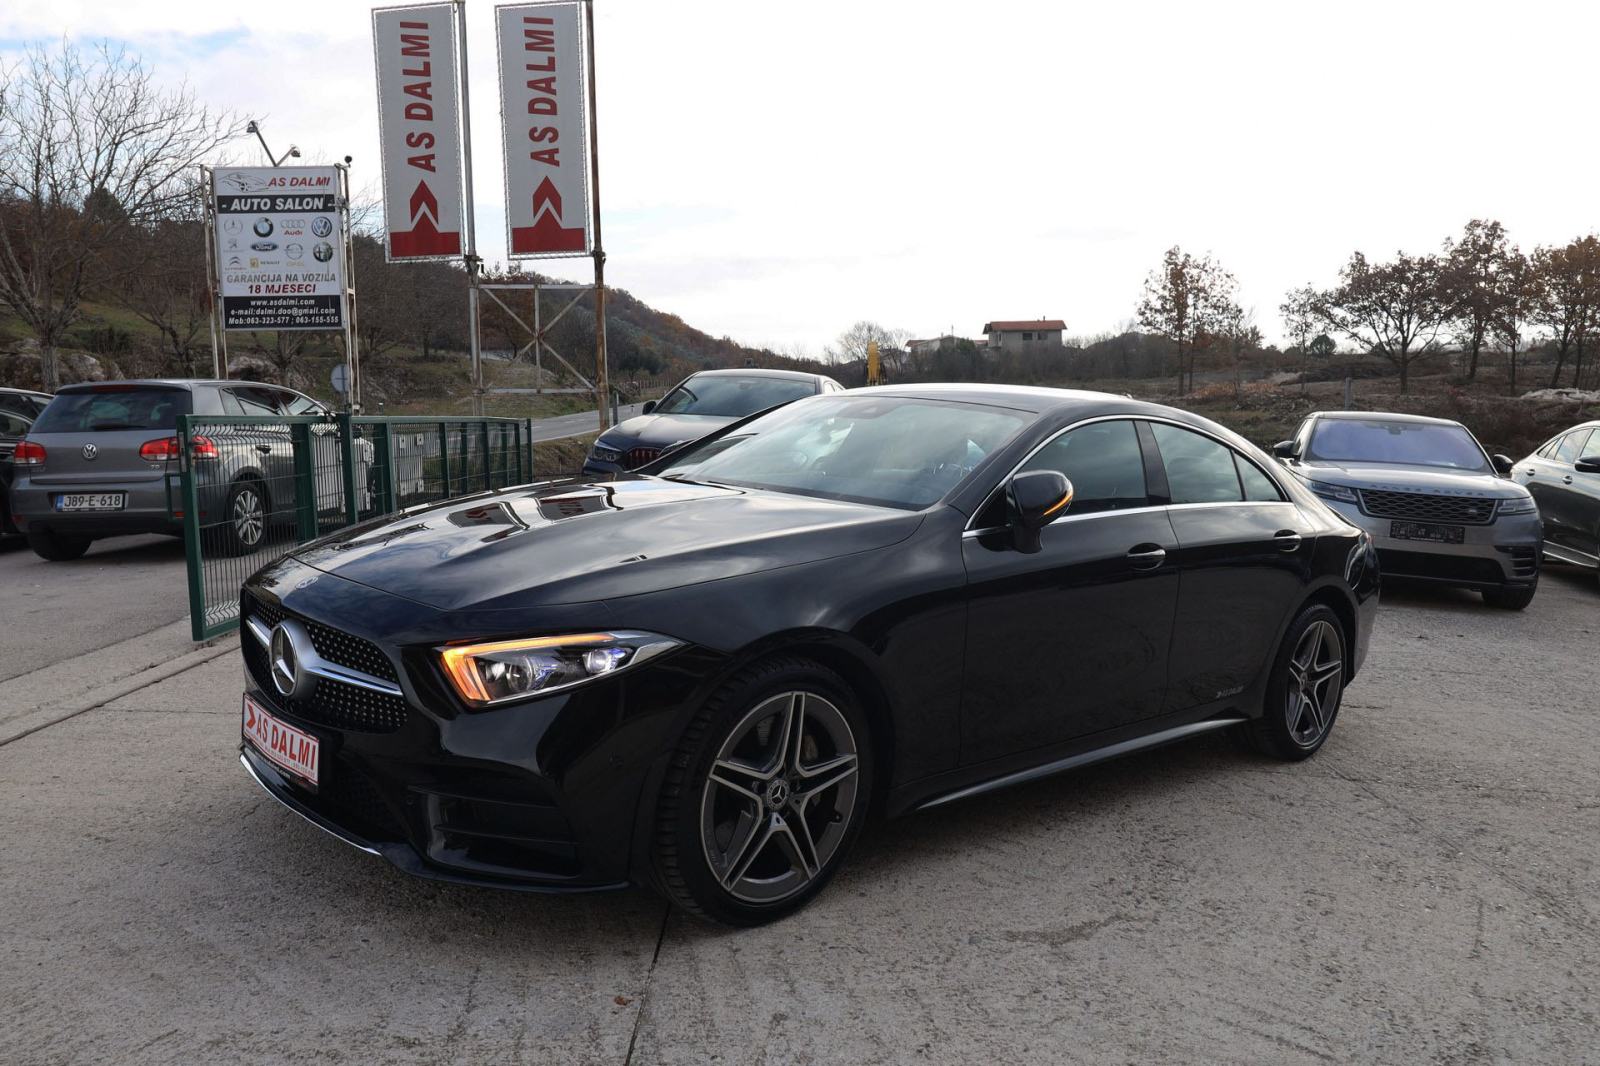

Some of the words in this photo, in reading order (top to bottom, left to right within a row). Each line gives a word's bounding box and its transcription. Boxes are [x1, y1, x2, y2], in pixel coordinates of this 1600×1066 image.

[400, 21, 433, 121] DALMI
[523, 16, 558, 116] DALMI
[406, 132, 436, 173] AS
[528, 126, 560, 167] AS
[268, 177, 286, 187] AS
[289, 176, 330, 187] DALMI
[230, 198, 271, 211] AUTO
[275, 197, 324, 210] SALON
[226, 274, 281, 283] GARANCIJA
[285, 273, 299, 281] NA
[302, 273, 336, 281] VOZILA
[248, 285, 261, 294] 18
[265, 284, 316, 294] MJESECI
[250, 298, 315, 306] www.asdalmi.com
[64, 495, 121, 507] J89-E-618
[256, 713, 269, 743] AS
[271, 724, 316, 770] DALMI
